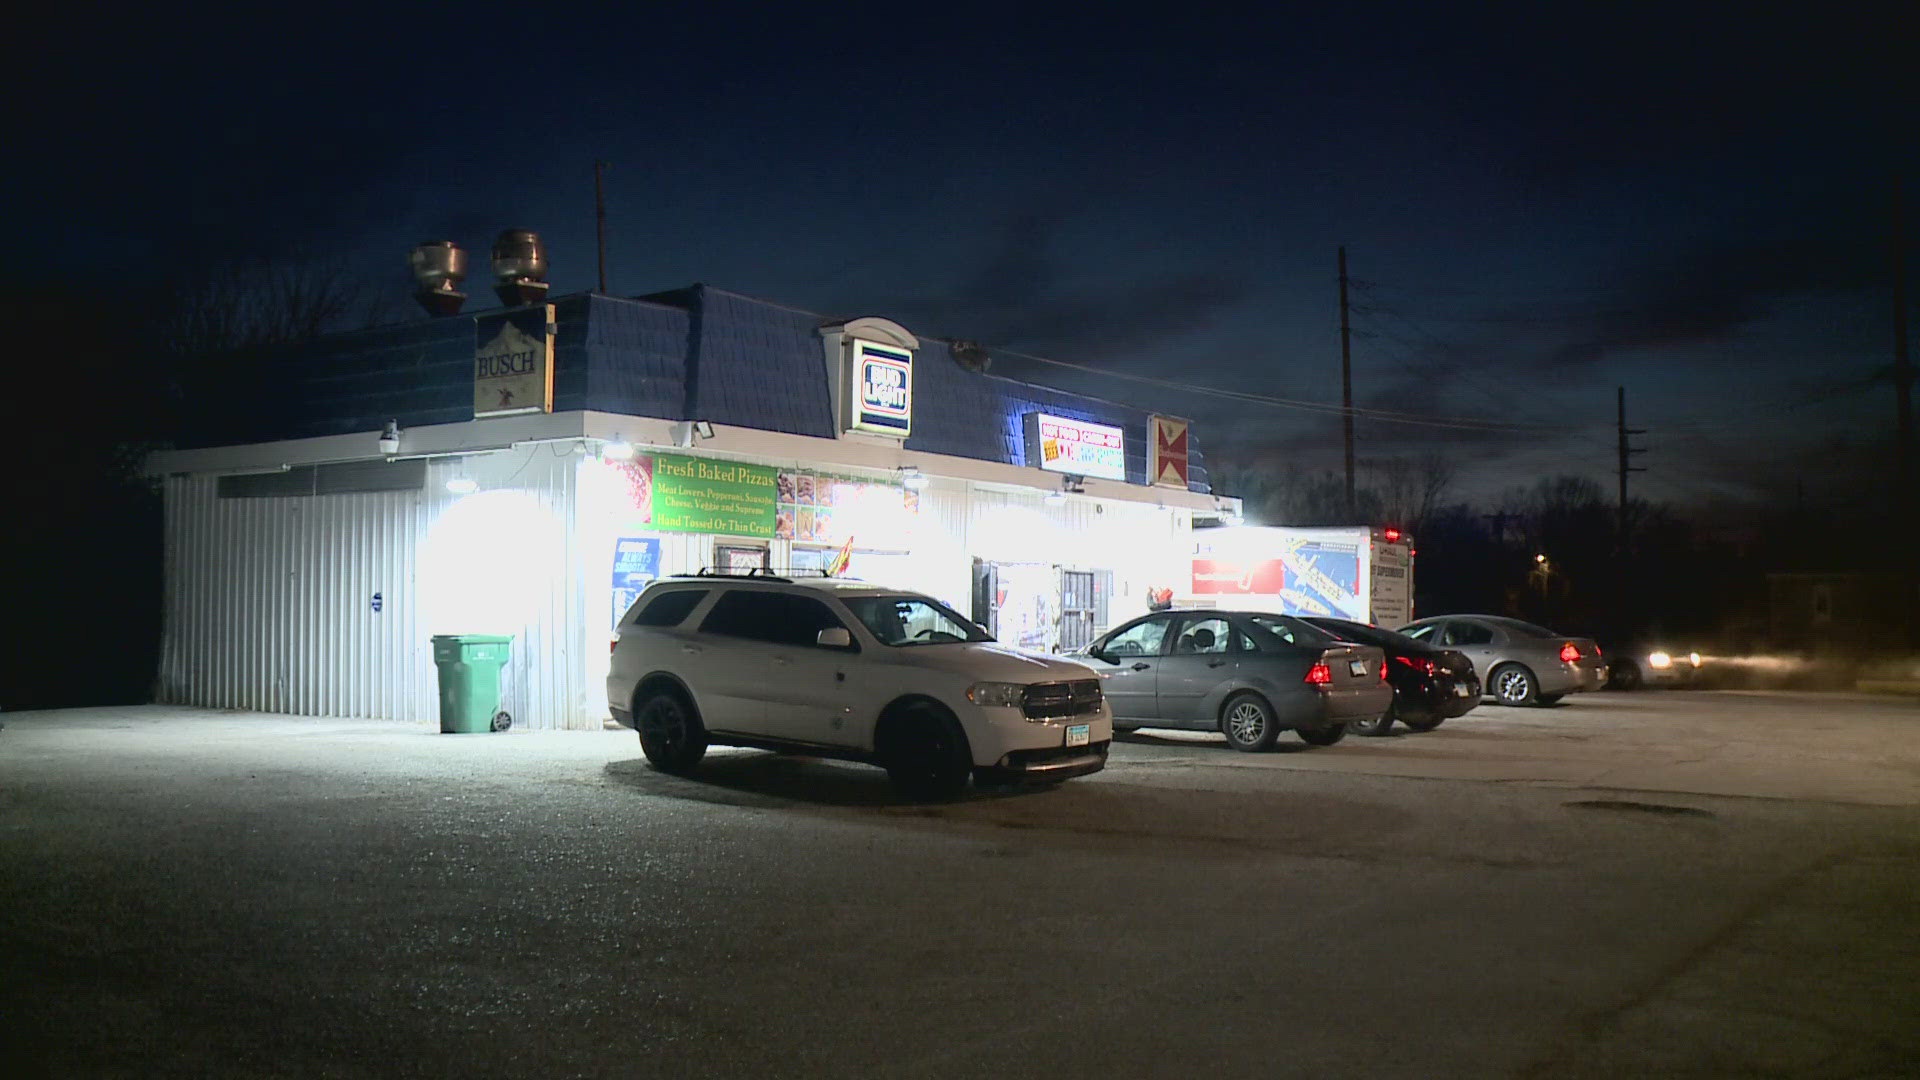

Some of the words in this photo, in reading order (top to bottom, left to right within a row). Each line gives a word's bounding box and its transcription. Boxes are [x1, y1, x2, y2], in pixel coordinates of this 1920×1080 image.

[477, 349, 536, 377] BUSCH
[870, 365, 902, 387] BUD
[864, 381, 906, 407] LIGHT
[657, 457, 695, 478] Fresh
[698, 462, 735, 482] Baked
[738, 467, 775, 487] Pizzas
[657, 482, 677, 495] Meat
[694, 498, 719, 512] Veggie
[721, 502, 735, 512] and
[735, 502, 765, 515] Supreme
[657, 513, 682, 527] Hand
[684, 515, 713, 530] Tossed
[714, 518, 727, 530] Or
[728, 519, 748, 533] Thin
[749, 521, 772, 535] Crust
[620, 551, 653, 564] ALWAYS
